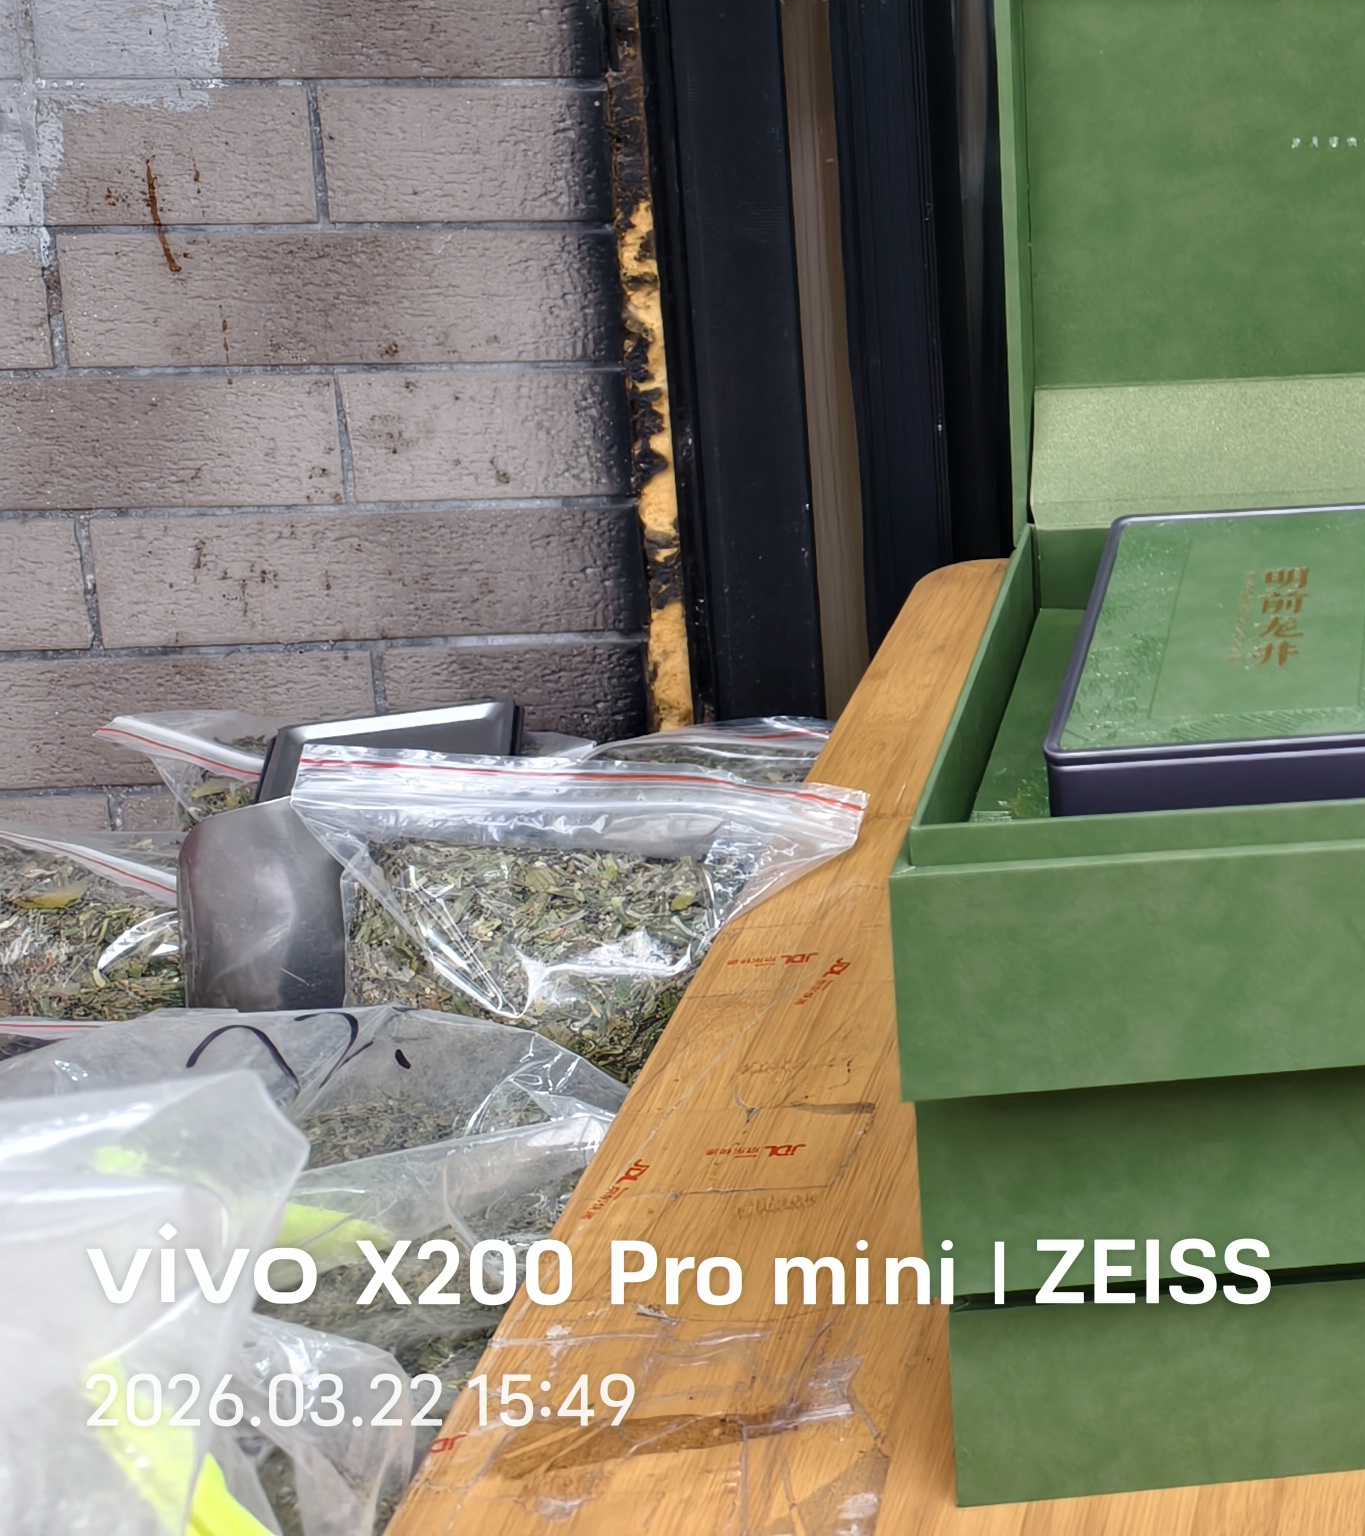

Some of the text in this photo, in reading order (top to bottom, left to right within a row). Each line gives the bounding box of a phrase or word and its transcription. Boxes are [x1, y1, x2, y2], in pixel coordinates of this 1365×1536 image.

[1251, 565, 1310, 668] 明前龙井
[781, 951, 819, 965] JDL
[762, 1143, 807, 1159] JDL
